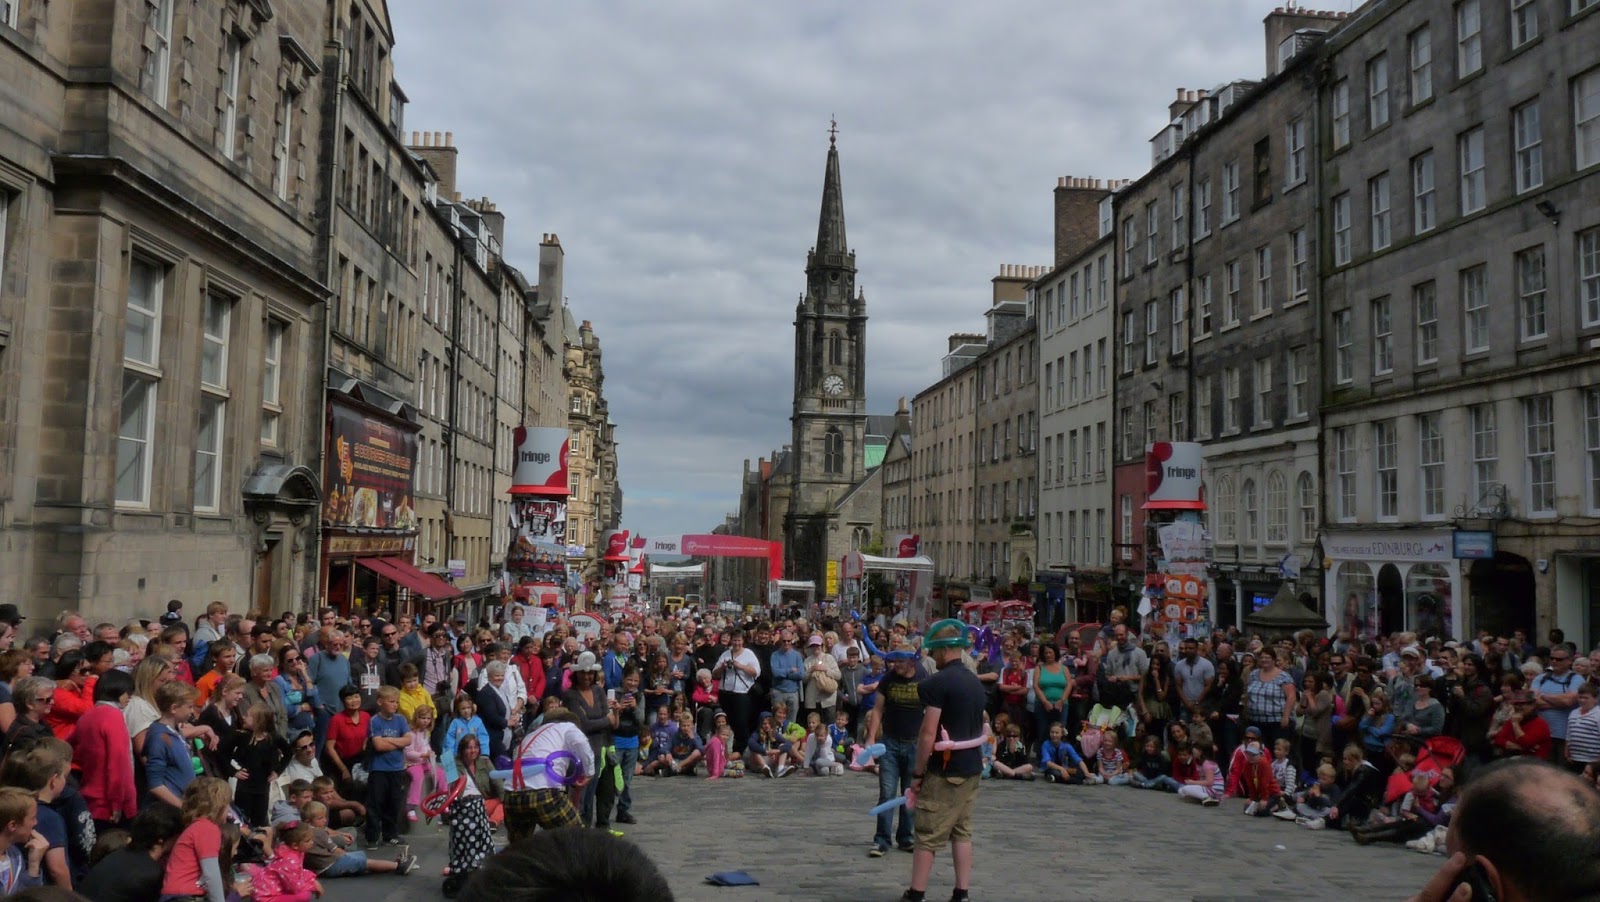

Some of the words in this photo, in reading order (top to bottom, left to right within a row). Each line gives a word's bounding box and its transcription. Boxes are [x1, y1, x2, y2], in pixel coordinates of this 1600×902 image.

[521, 450, 550, 465] fringe
[1167, 466, 1196, 480] fringe
[655, 541, 676, 552] fringe
[572, 619, 592, 629] fringe
